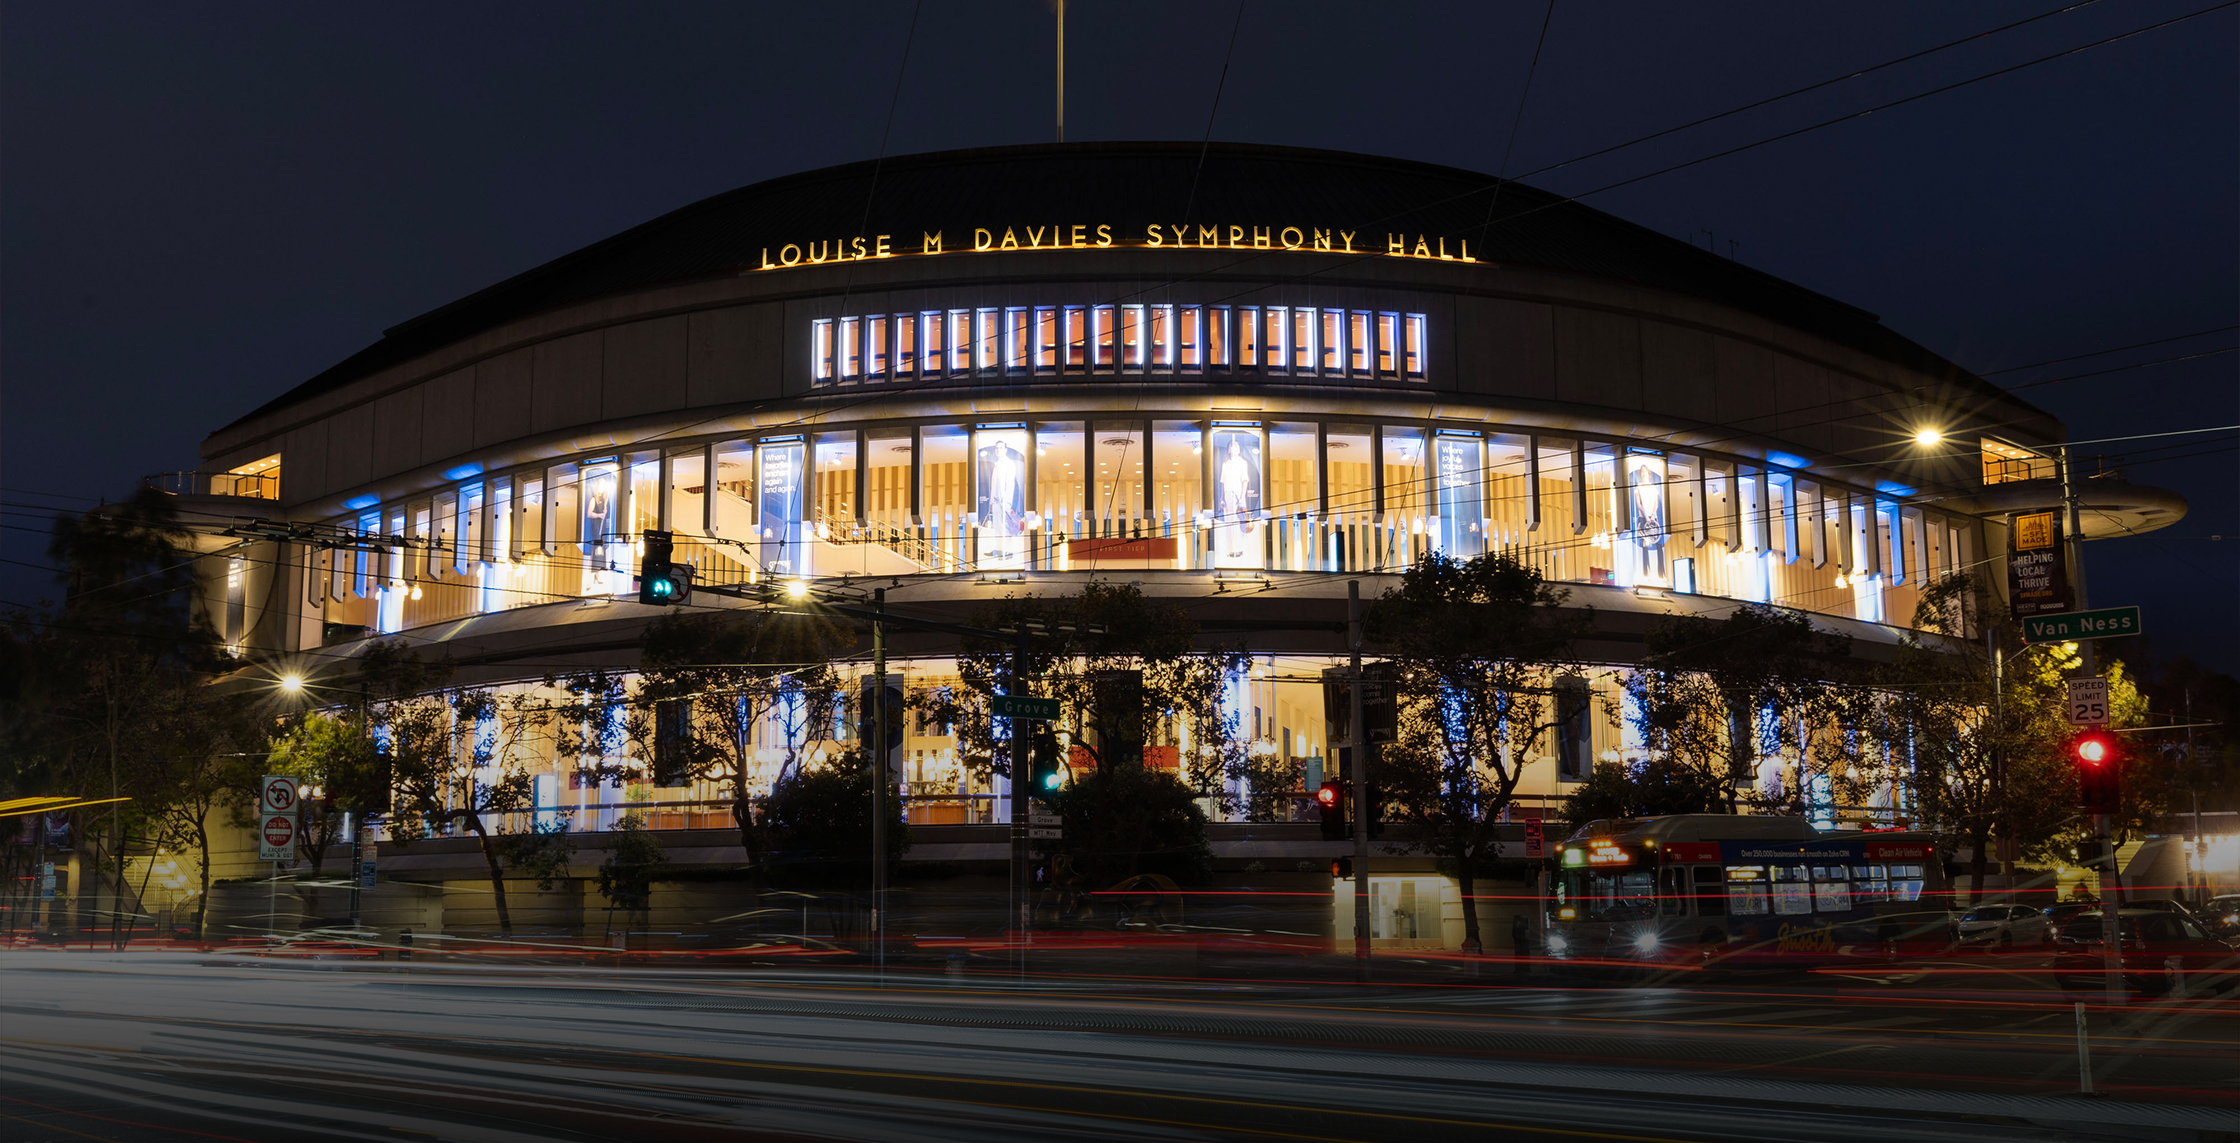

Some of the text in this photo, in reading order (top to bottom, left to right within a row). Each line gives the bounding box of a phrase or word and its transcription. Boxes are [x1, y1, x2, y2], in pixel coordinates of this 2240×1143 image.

[762, 223, 1476, 269] LOUISE M DAVIES SYMPHONY HALL
[2022, 537, 2048, 545] MADE
[2017, 553, 2054, 565] HELPING
[2018, 566, 2045, 577] LOCAL
[2018, 577, 2050, 589] THRIVE
[2032, 616, 2132, 636] Van Ness
[2072, 681, 2104, 691] SPEED
[2075, 692, 2101, 701] LIMIT
[1004, 700, 1049, 715] Grove
[2075, 703, 2104, 720] 25
[1740, 849, 1752, 857] Over
[1752, 849, 1773, 858] 250,000
[1878, 847, 1923, 857] Clean Air Vehicle
[1776, 921, 1836, 956] Smooth
